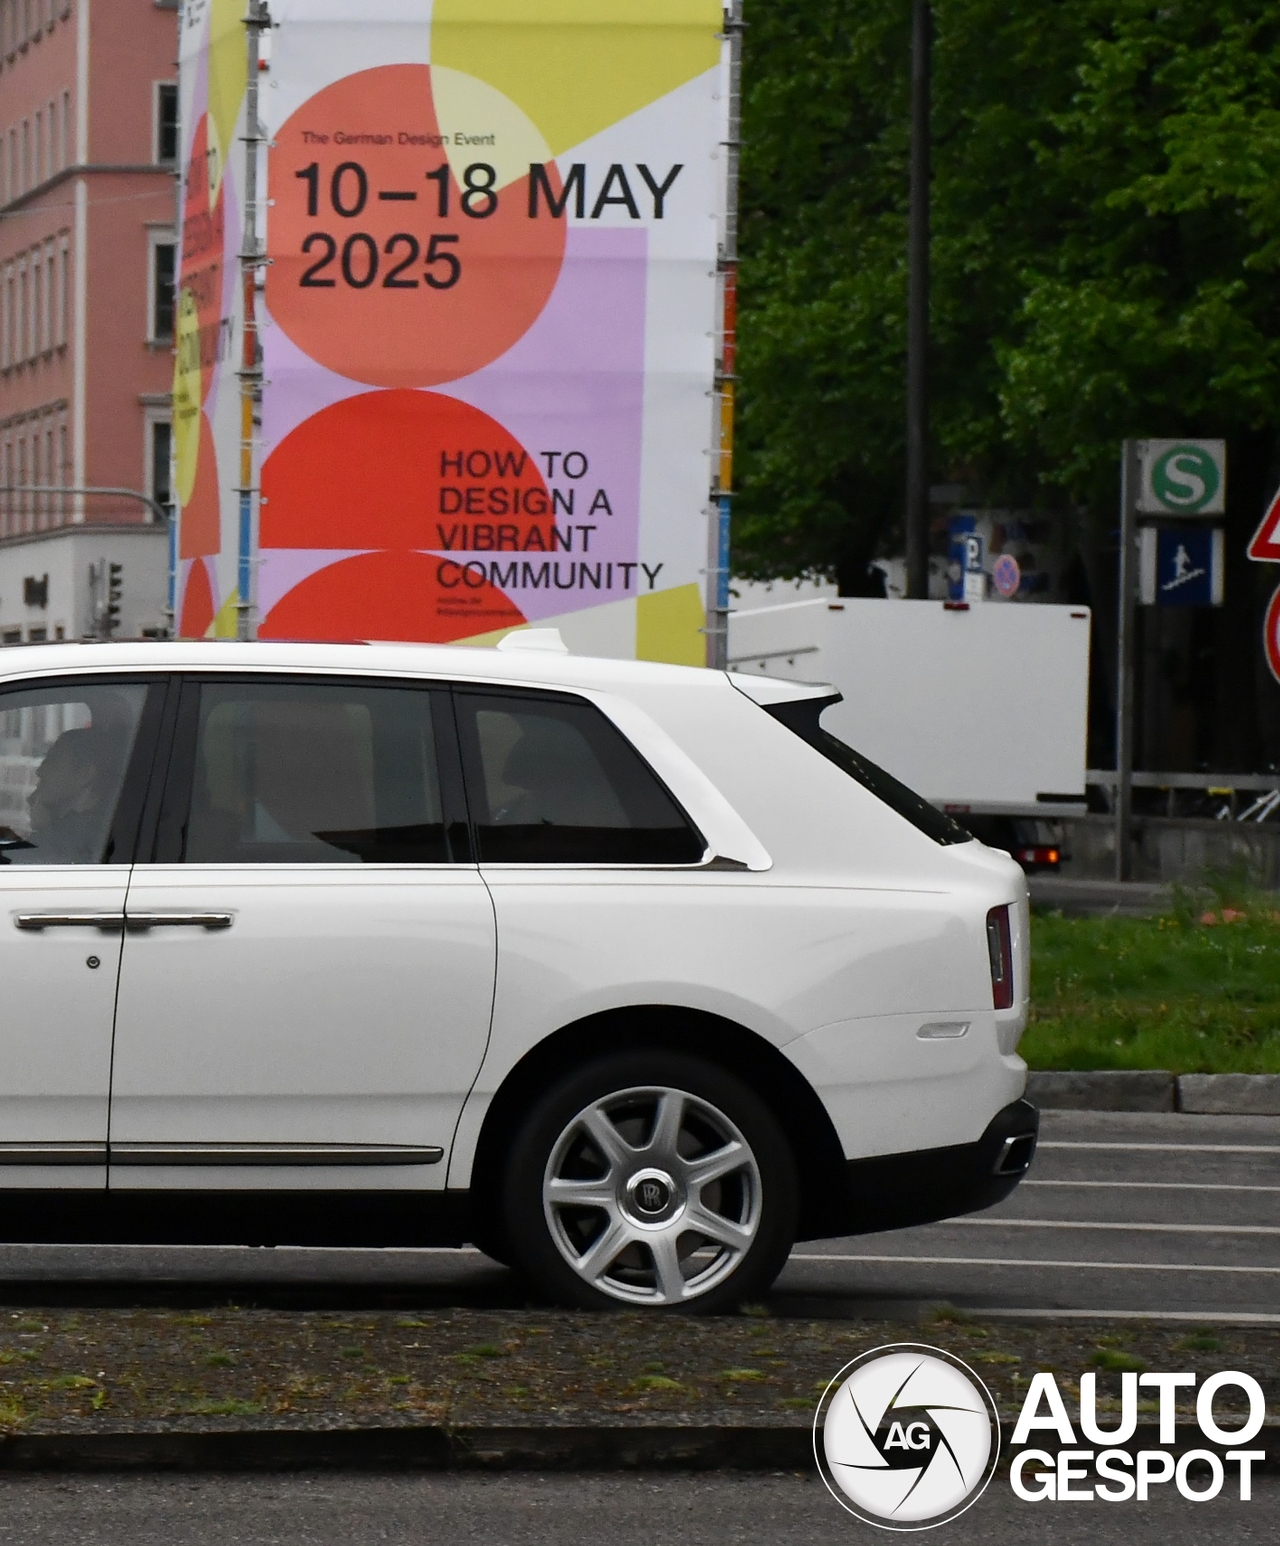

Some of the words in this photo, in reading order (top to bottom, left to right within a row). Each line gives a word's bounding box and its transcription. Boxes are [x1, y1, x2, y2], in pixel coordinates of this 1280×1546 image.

[302, 131, 329, 145] The
[333, 131, 393, 146] German
[398, 132, 449, 149] Design
[454, 132, 496, 146] Event
[528, 163, 684, 219] MAY
[299, 232, 462, 289] 2025
[440, 451, 528, 478] HOW
[540, 451, 589, 479] TO
[1164, 453, 1206, 505] S
[439, 487, 574, 516] DESIGN
[588, 488, 613, 516] A
[436, 523, 596, 552] VIBRANT
[436, 560, 664, 590] COMMUNITY
